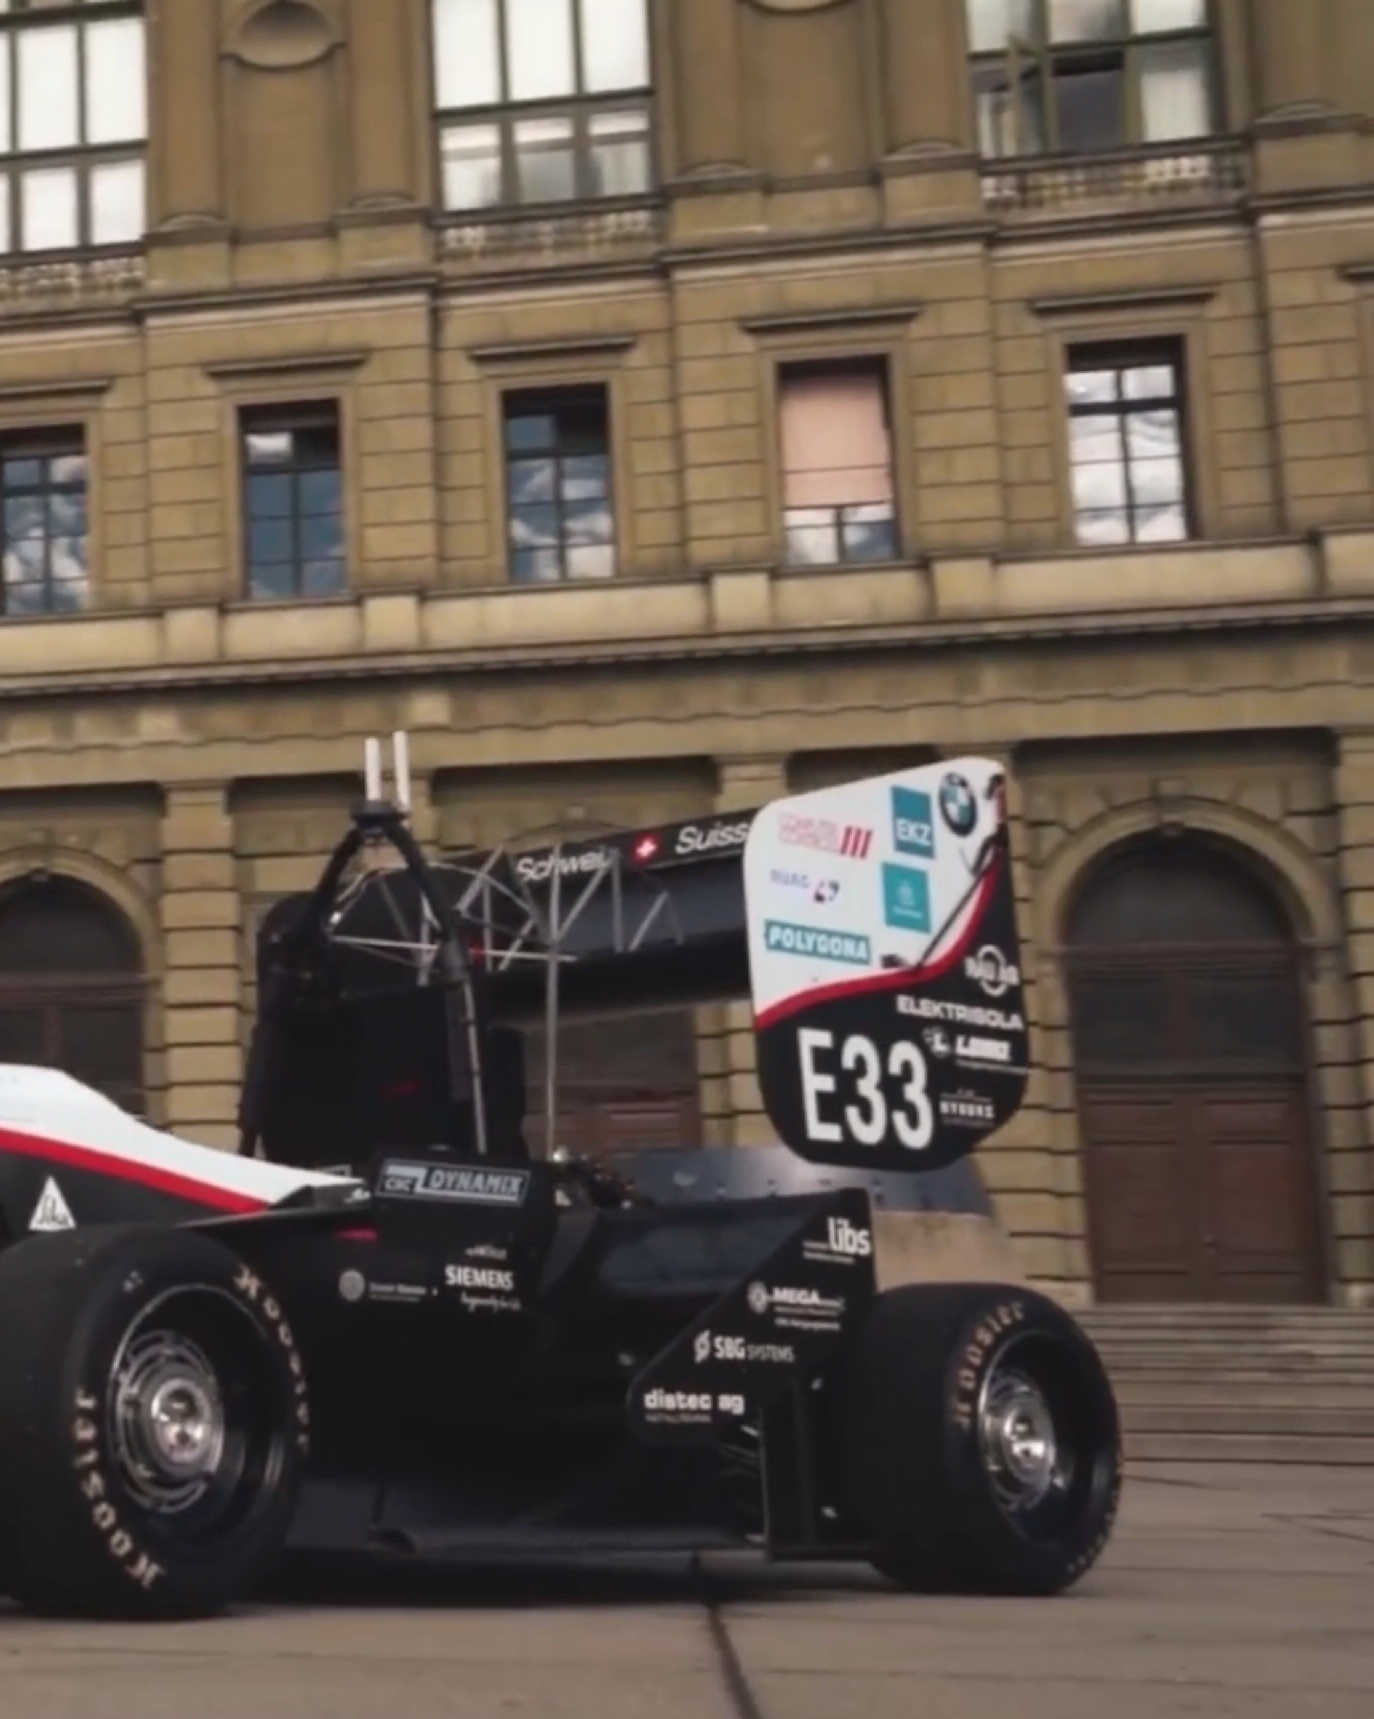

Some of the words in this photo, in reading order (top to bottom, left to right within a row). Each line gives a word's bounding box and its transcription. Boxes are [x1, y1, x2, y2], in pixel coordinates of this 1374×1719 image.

[896, 819, 930, 846] EKZ
[769, 926, 868, 961] POLYGONA
[896, 995, 1024, 1030] ELEKTRISOLA
[798, 1027, 934, 1151] E33
[430, 1169, 523, 1195] DYNAMIX
[827, 1216, 871, 1256] libs
[444, 1264, 514, 1291] SIEMENS
[713, 1336, 745, 1360] SBG
